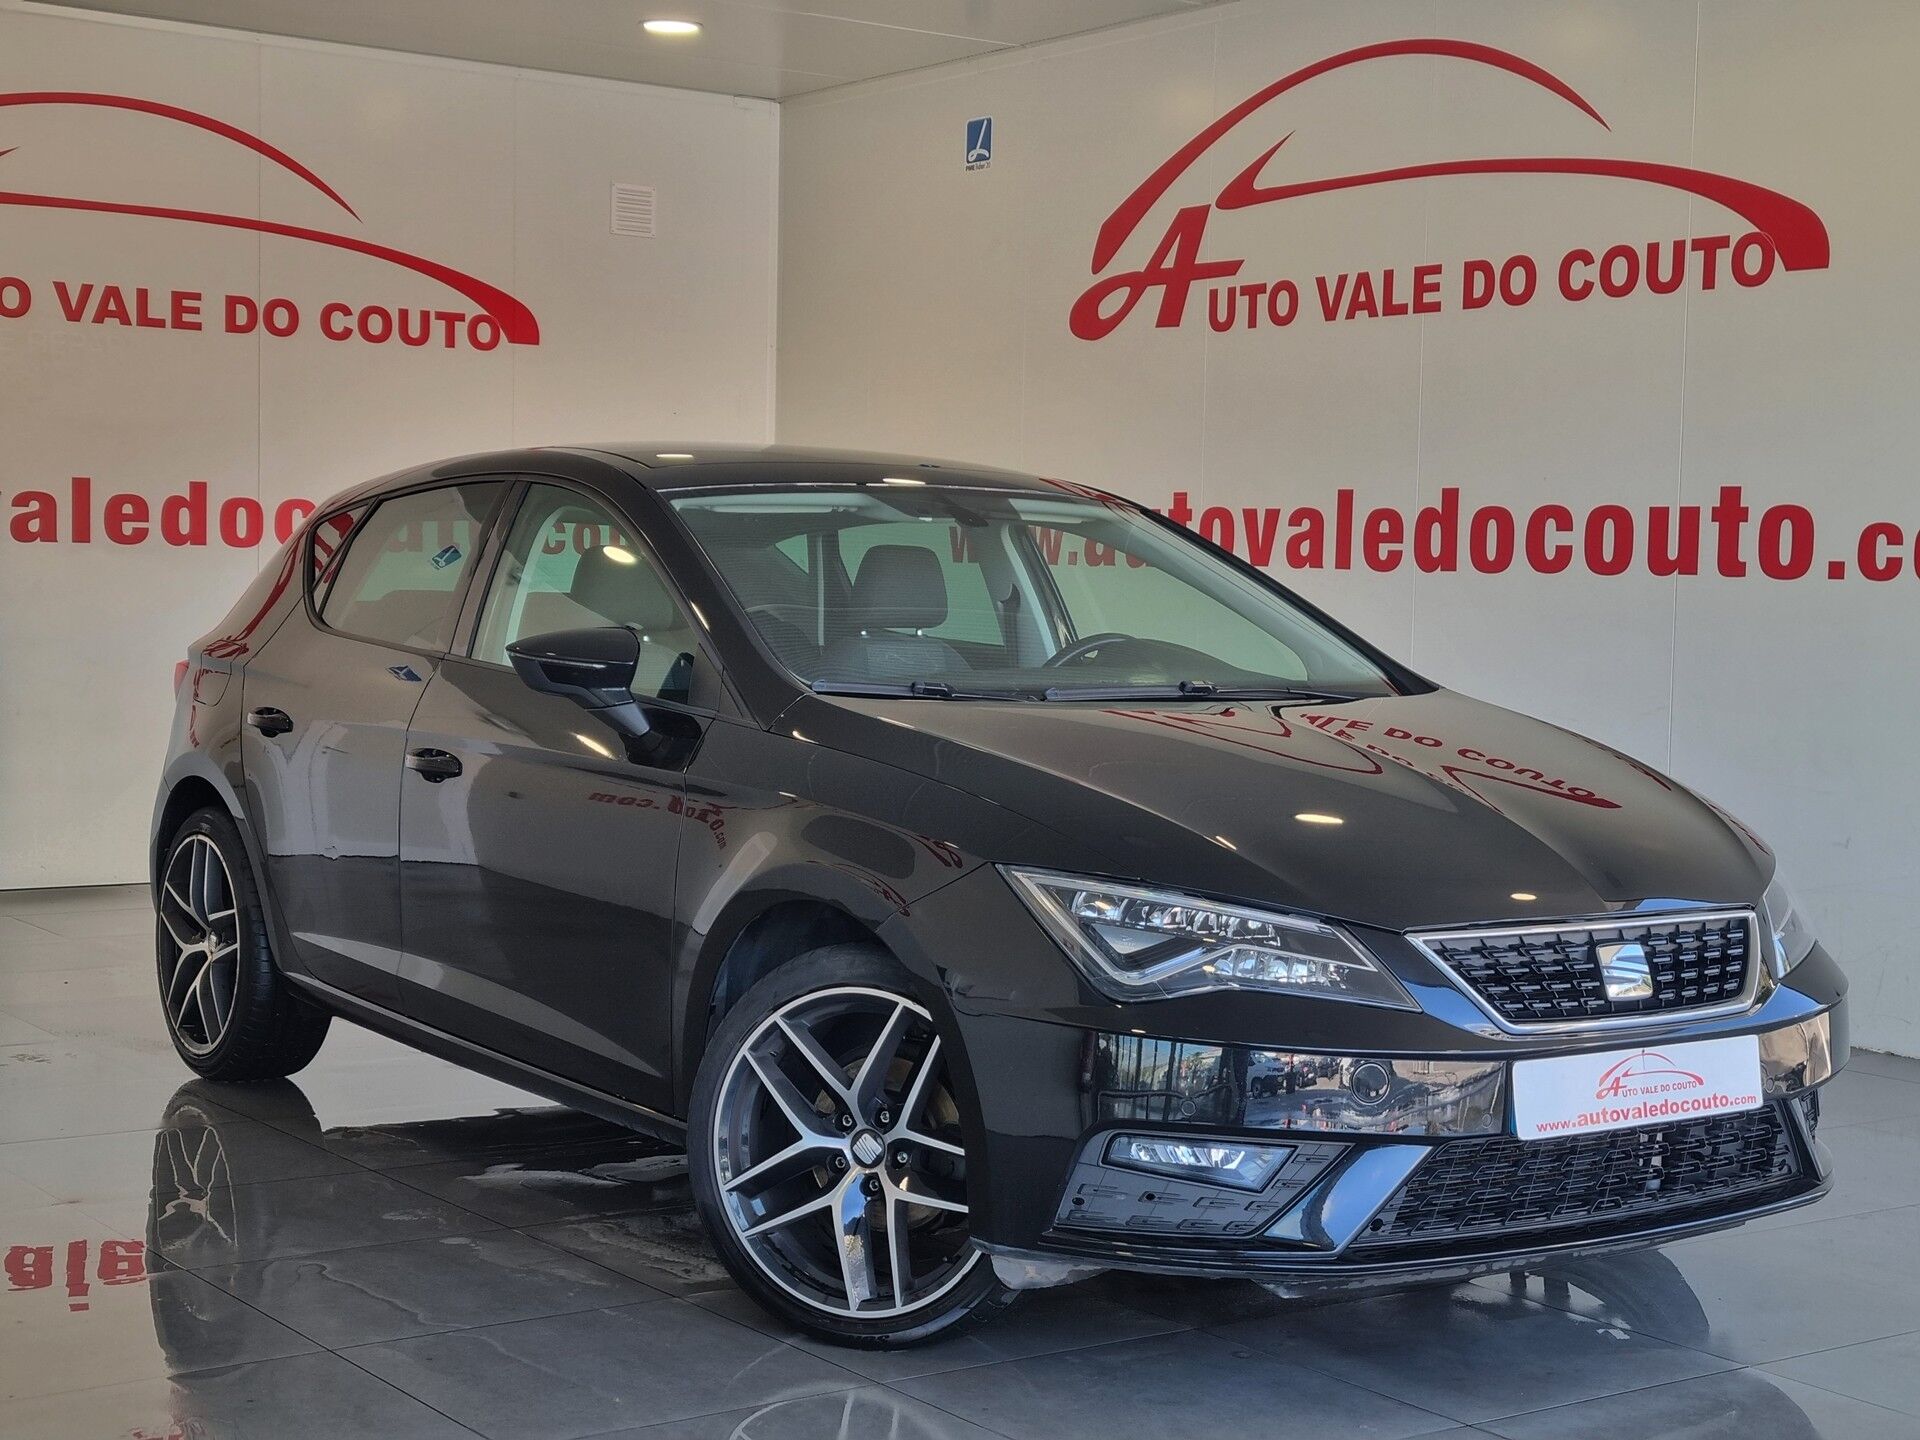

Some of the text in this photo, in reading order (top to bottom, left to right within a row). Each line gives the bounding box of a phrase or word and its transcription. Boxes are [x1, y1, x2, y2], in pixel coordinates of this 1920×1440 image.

[1315, 264, 1442, 322] VALE
[1462, 254, 1538, 310] DO
[1558, 231, 1776, 302] COUTO
[52, 280, 203, 331] VALE
[224, 294, 300, 338] DO
[320, 302, 501, 352] COUTO
[1536, 1092, 1757, 1132] www.autovaledocouto.com
[1640, 1084, 1659, 1095] VALE
[1660, 1083, 1671, 1092] DO
[1672, 1080, 1697, 1091] COUTO
